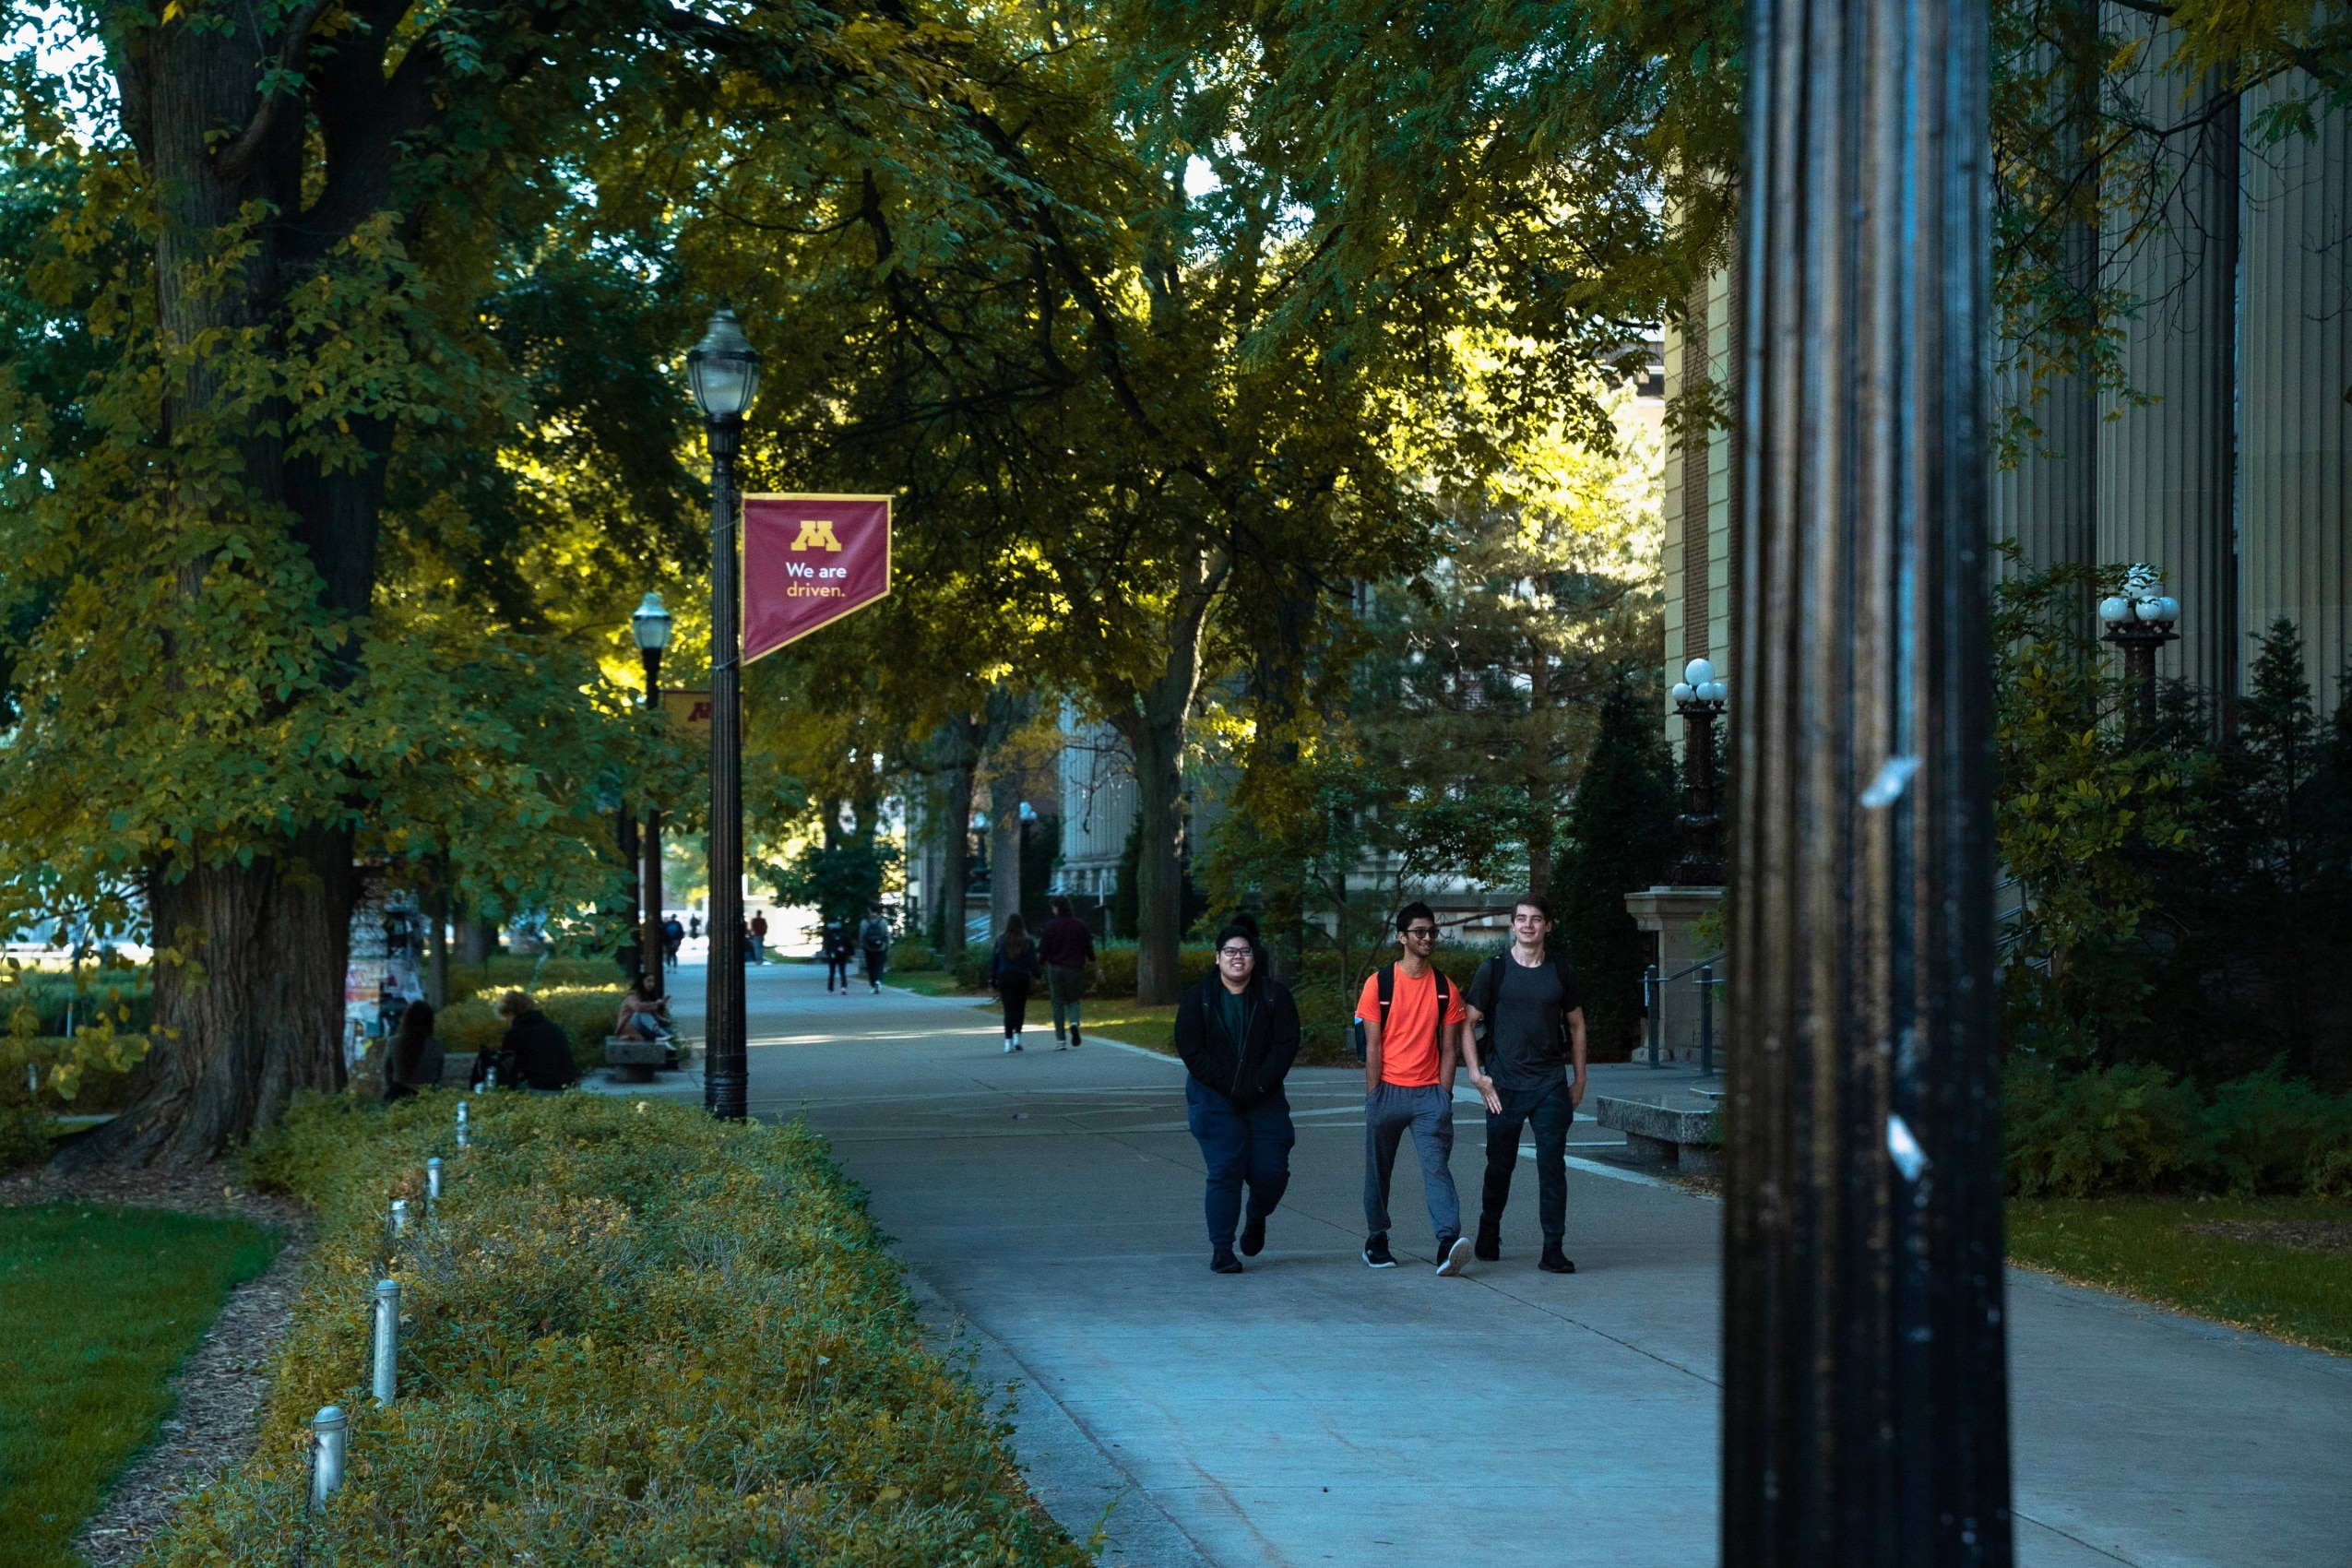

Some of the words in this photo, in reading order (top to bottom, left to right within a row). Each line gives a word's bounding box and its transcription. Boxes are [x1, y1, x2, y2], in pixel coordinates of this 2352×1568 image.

[790, 520, 842, 552] M
[785, 562, 814, 578] We
[818, 566, 847, 578] are
[787, 581, 846, 597] driven.
